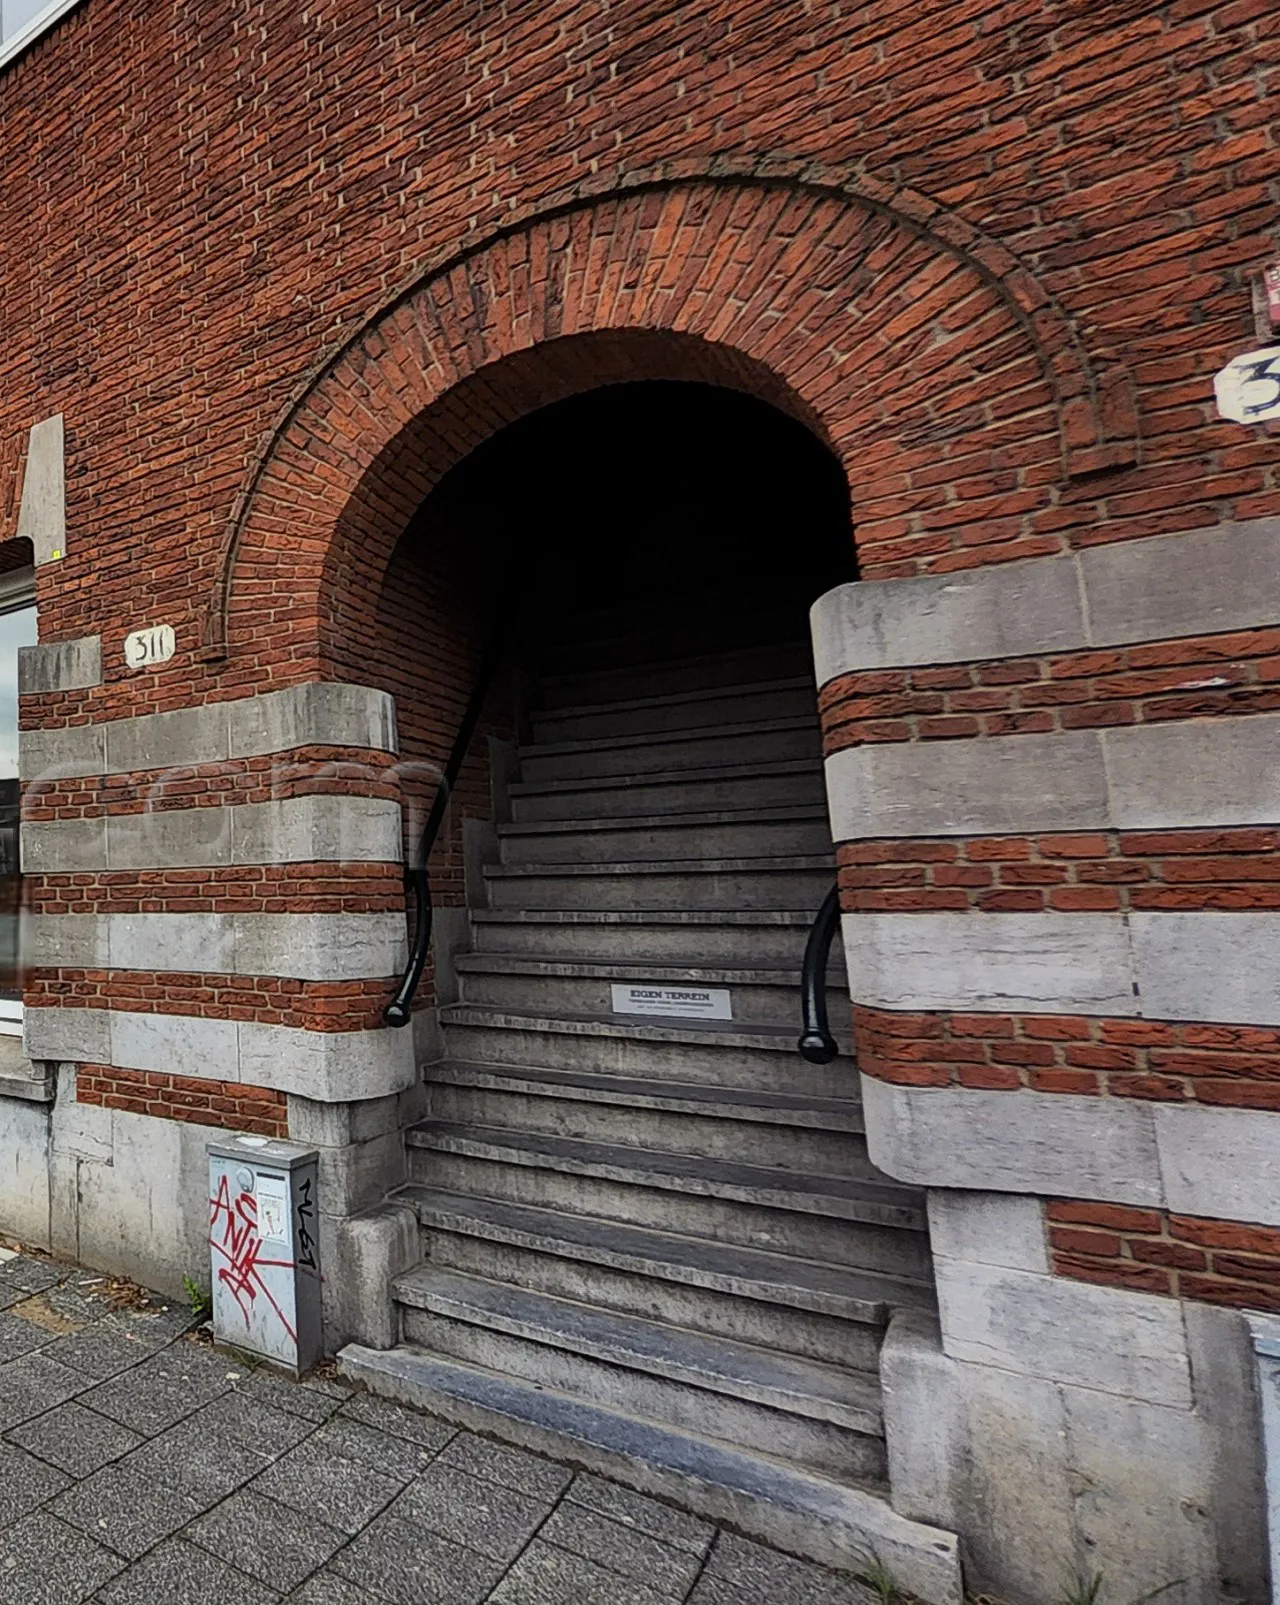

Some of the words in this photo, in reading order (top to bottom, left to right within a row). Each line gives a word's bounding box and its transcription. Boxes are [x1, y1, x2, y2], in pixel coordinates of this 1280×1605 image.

[135, 630, 165, 661] 311
[630, 990, 662, 998] EIGEN
[665, 991, 710, 1000] TERREIN
